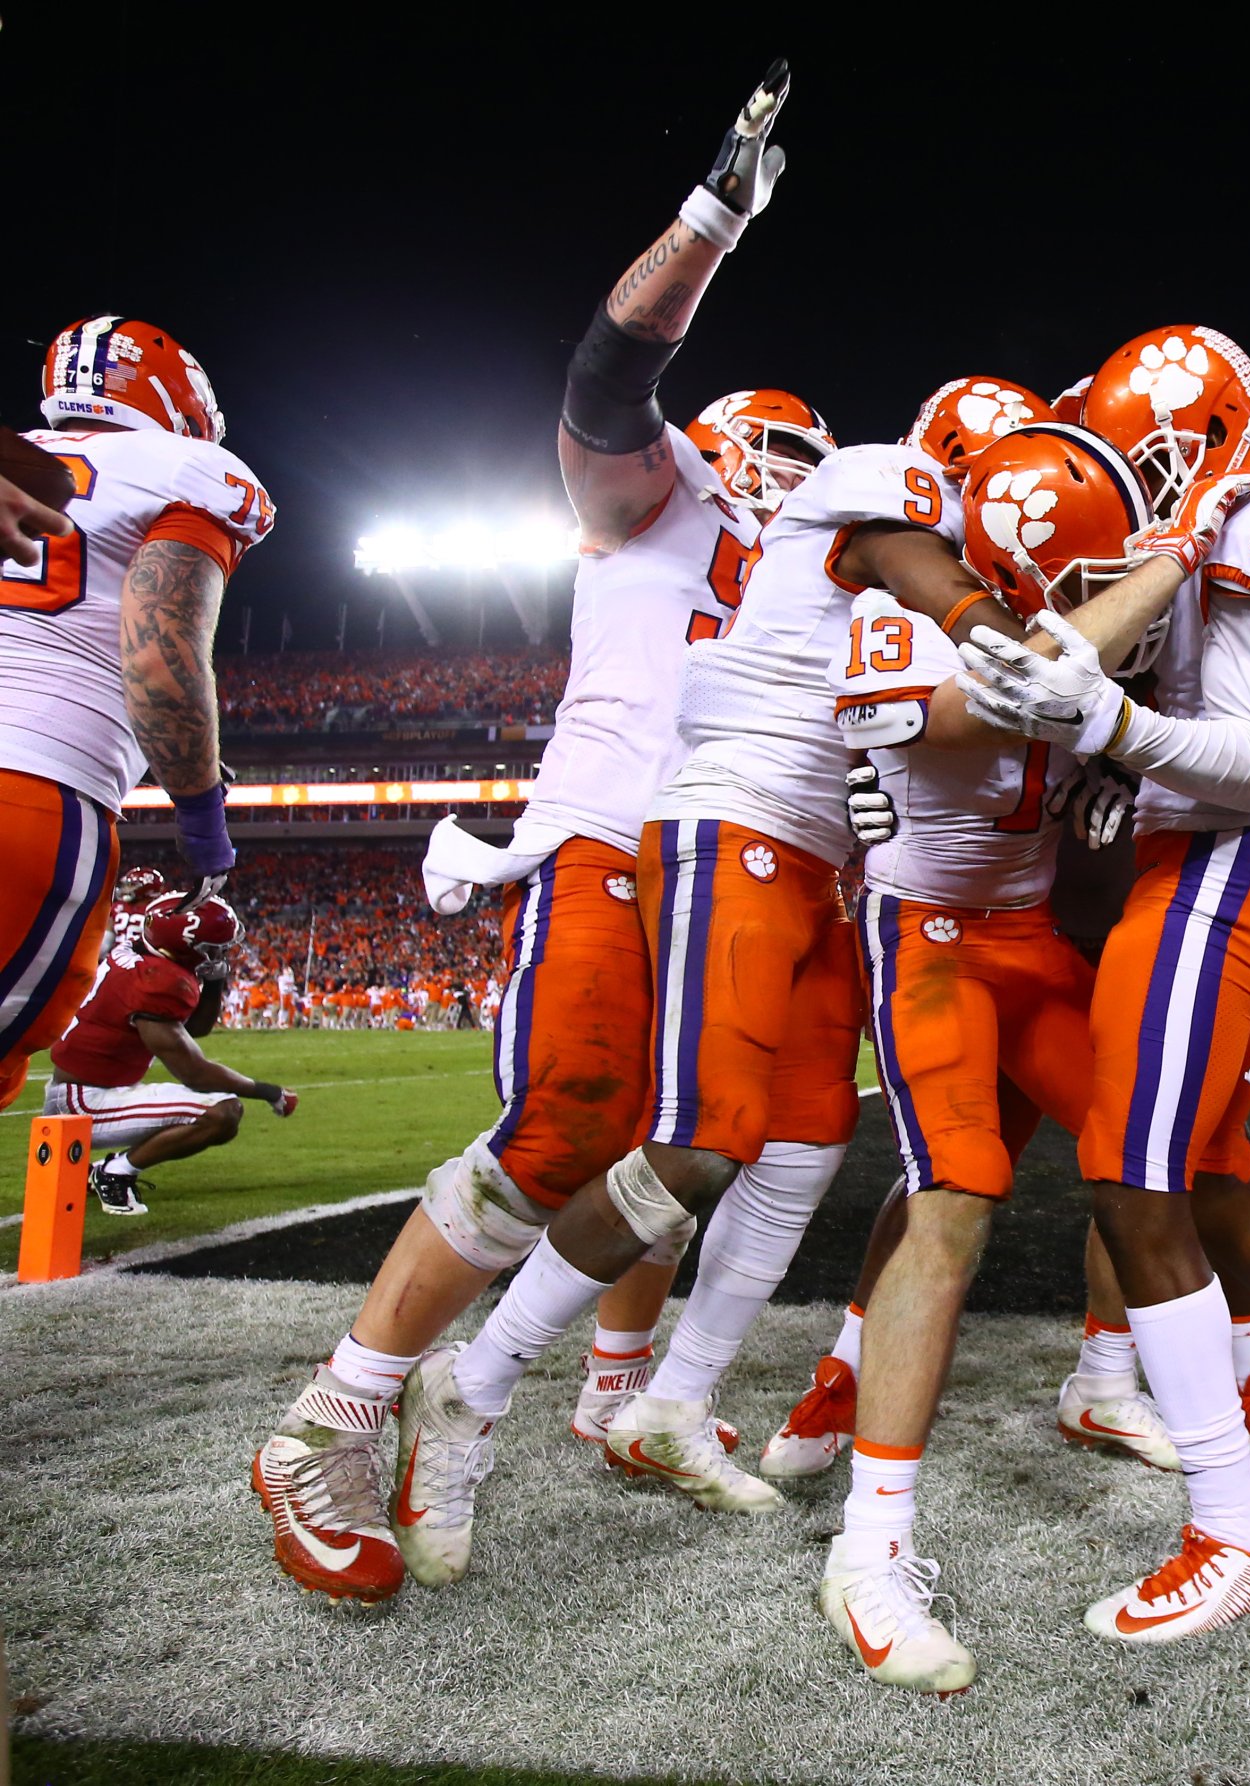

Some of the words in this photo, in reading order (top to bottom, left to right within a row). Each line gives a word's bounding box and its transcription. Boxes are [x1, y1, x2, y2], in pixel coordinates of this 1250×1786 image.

[93, 372, 104, 386] 6
[903, 466, 943, 528] 9
[845, 615, 914, 680] 13
[182, 914, 201, 939] 2
[596, 1373, 626, 1392] NIKE
